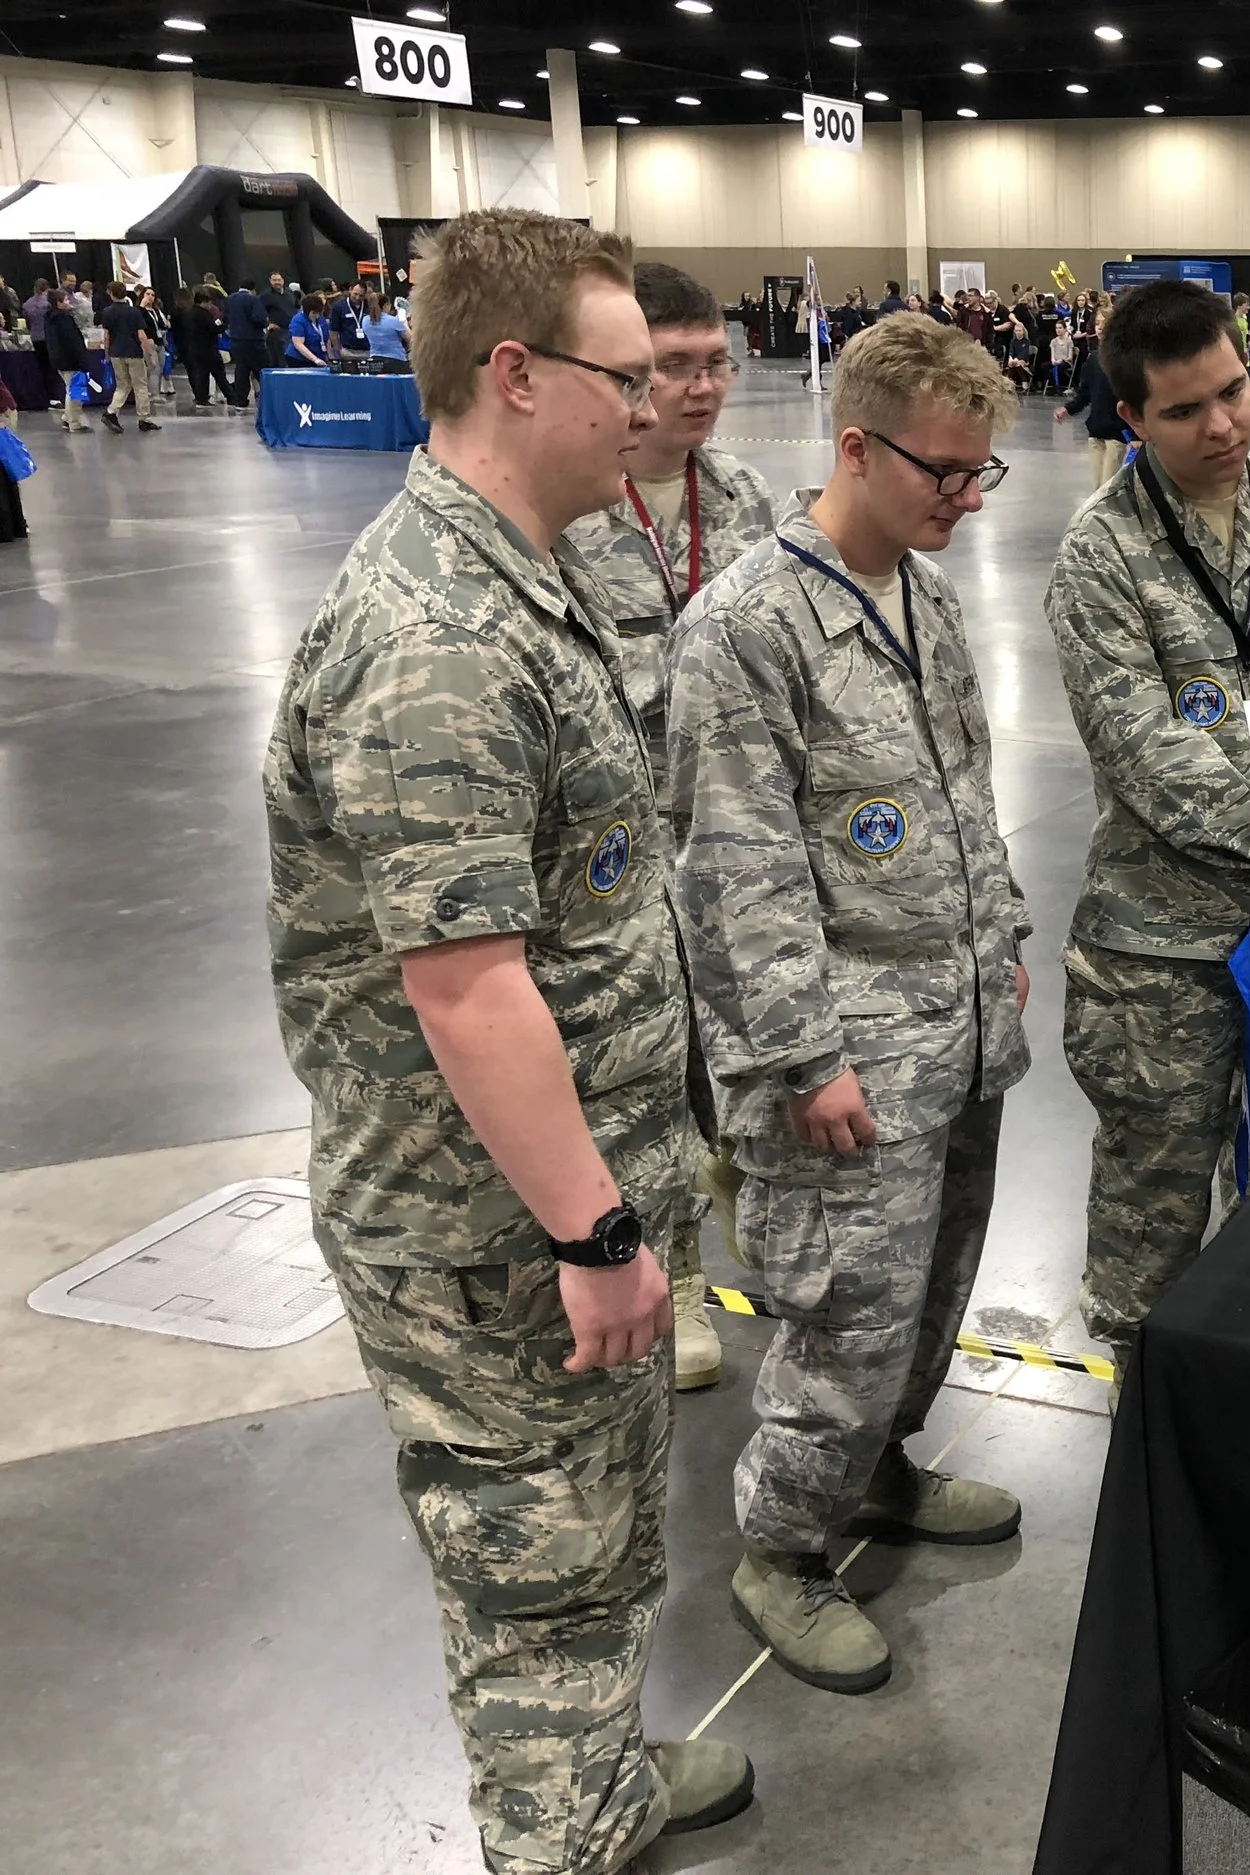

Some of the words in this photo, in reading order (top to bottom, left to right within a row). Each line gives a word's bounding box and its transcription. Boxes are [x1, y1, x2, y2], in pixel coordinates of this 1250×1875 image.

[374, 36, 451, 88] 800
[814, 106, 855, 143] 900
[311, 411, 340, 422] Imagine
[341, 411, 371, 422] Learning
